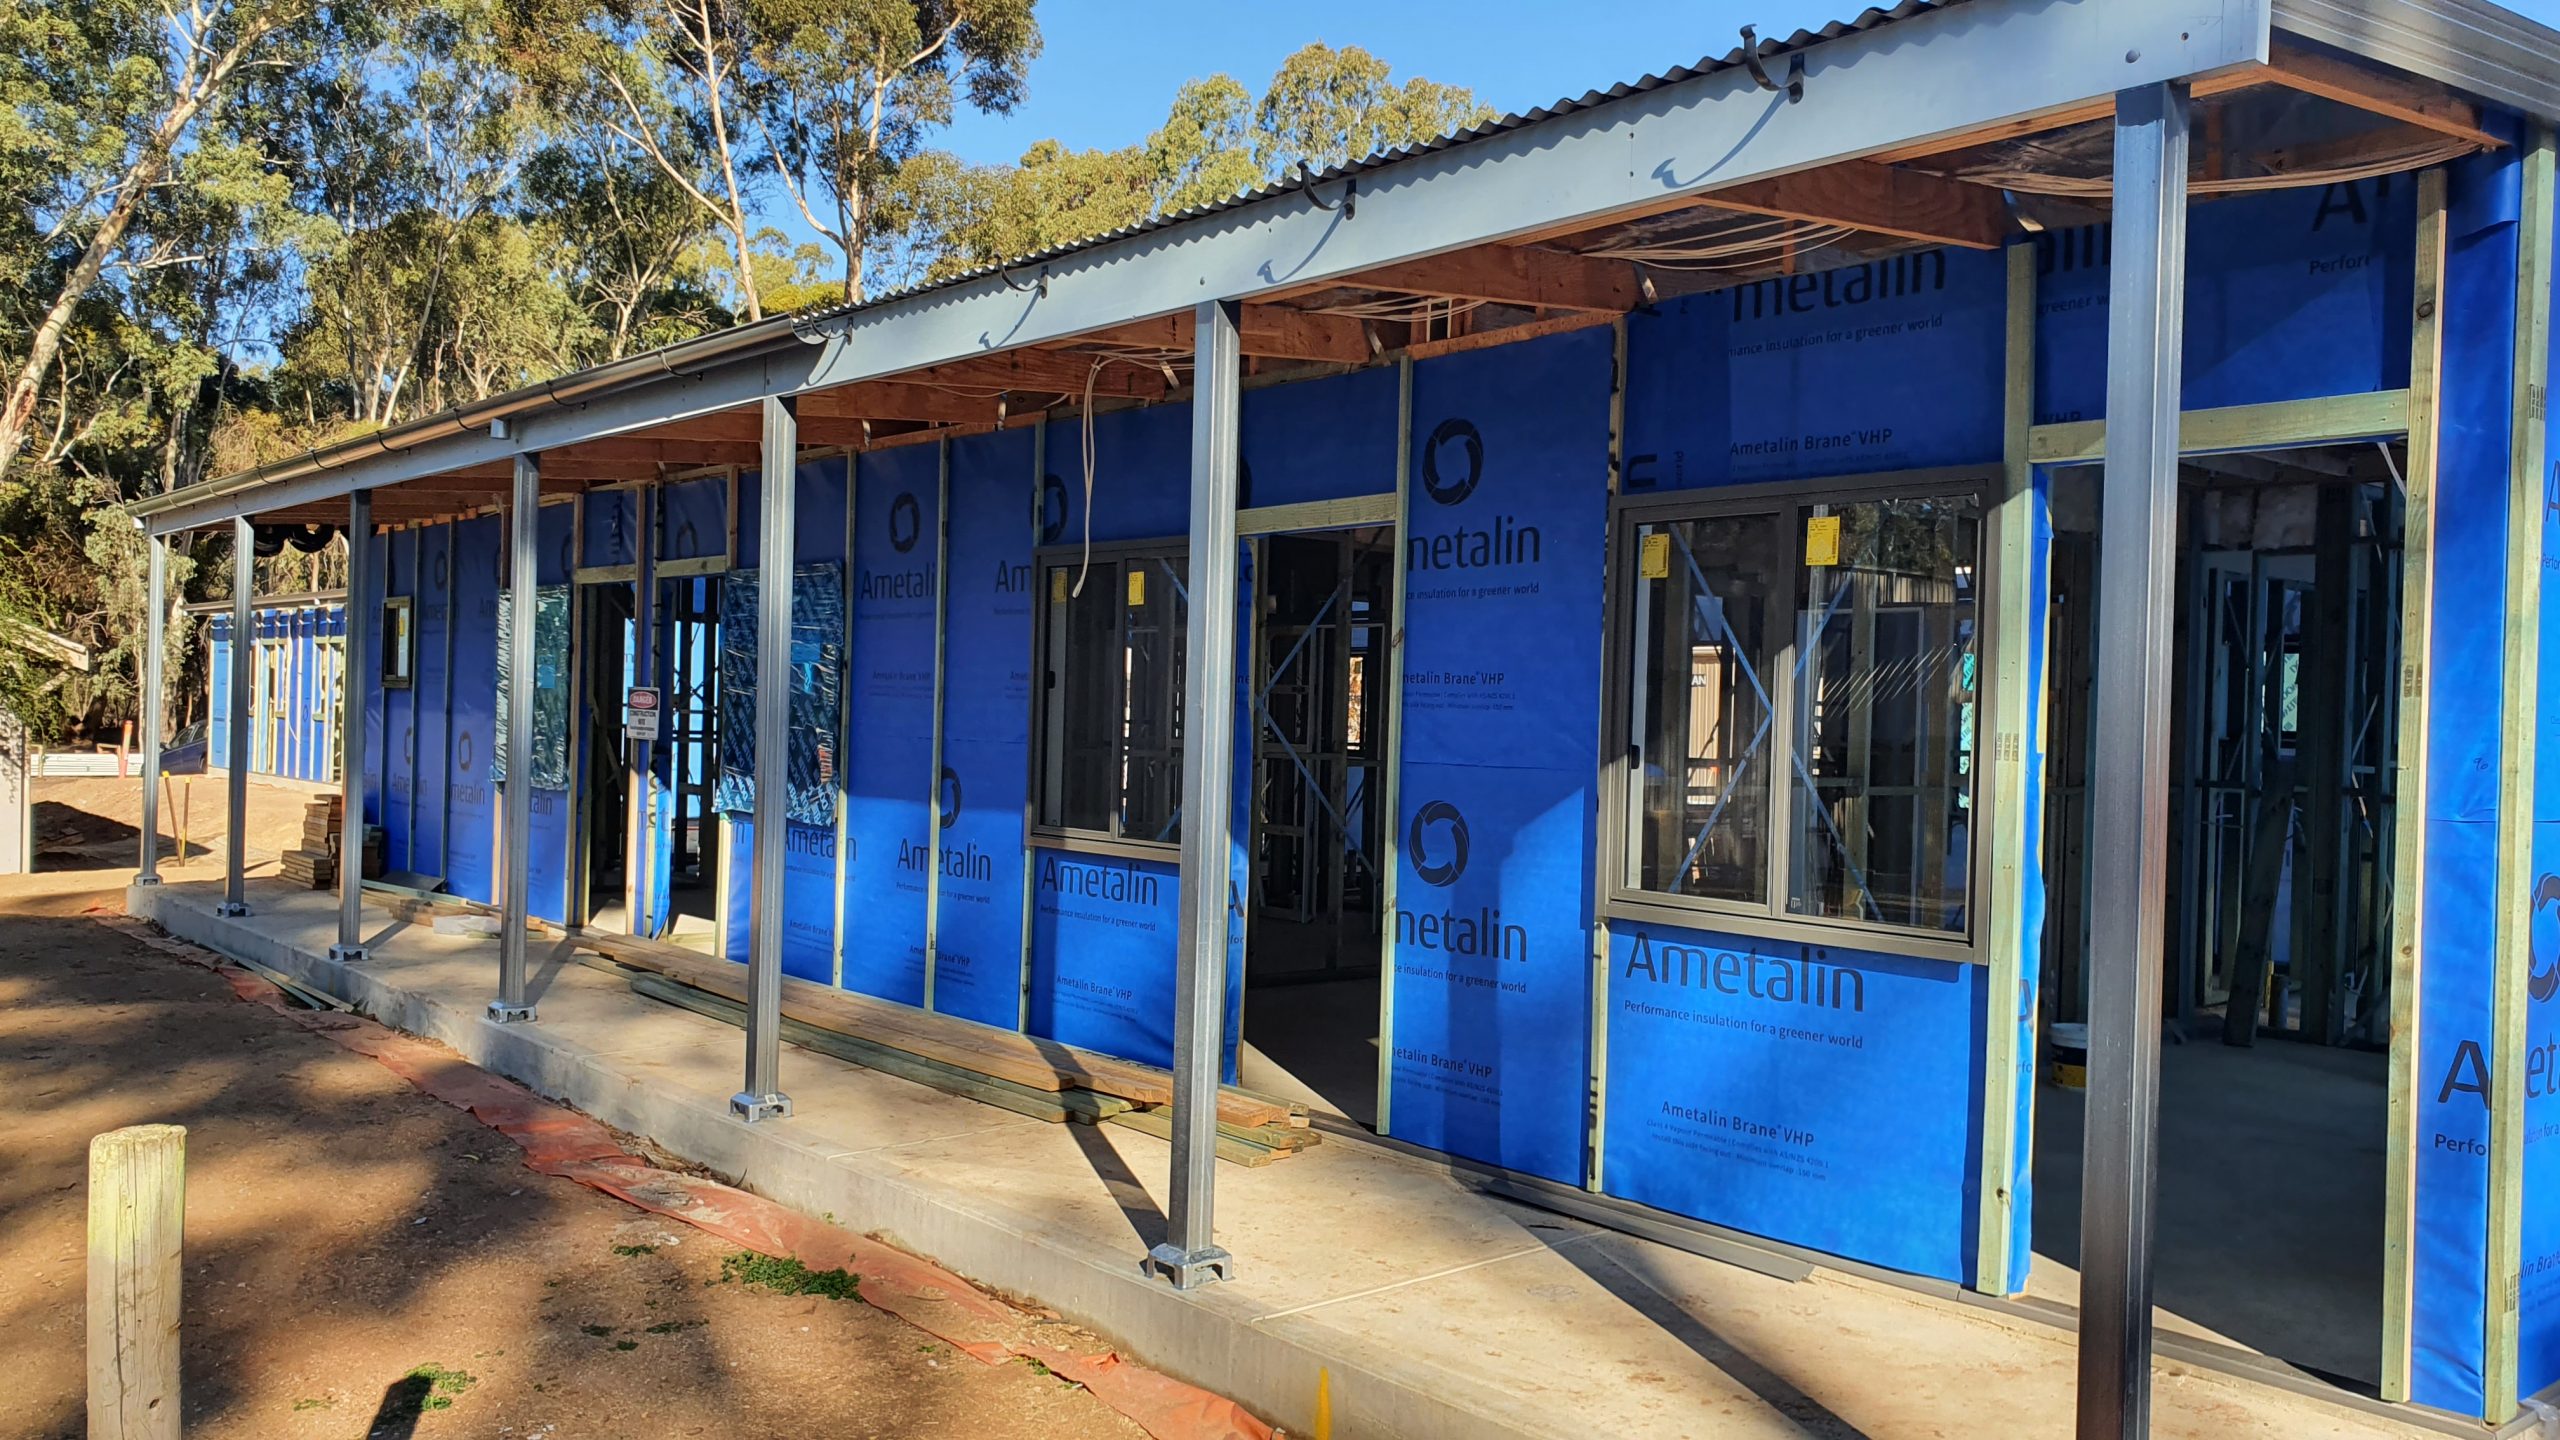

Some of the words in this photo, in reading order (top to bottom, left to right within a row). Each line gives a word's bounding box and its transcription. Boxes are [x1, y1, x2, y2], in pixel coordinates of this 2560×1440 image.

[1765, 333, 1823, 352] insulation
[1826, 330, 1843, 343] for
[1845, 331, 1854, 341] a
[1855, 322, 1904, 343] greener
[1907, 313, 1944, 332] world
[1729, 437, 1799, 456] Ametalin
[1858, 428, 1893, 446] VHP
[1458, 586, 1470, 598] for
[1513, 582, 1540, 595] world
[1481, 672, 1505, 685] VHP
[1041, 856, 1158, 907] Ametalin
[1404, 962, 1443, 980] insulation
[1445, 970, 1458, 982] for
[1465, 974, 1499, 989] greener
[1501, 981, 1527, 994] world
[1626, 931, 1863, 1013] Ametalin
[1624, 1000, 1690, 1022] Performance
[1692, 1009, 1748, 1031] insulation
[1750, 1020, 1767, 1034] for
[1769, 1024, 1776, 1036] a
[1779, 1026, 1824, 1043] greener
[1828, 1034, 1863, 1049] world
[1468, 1063, 1493, 1078] VHP
[1661, 1100, 1727, 1129] Ametalin
[1783, 1127, 1815, 1147] VHP
